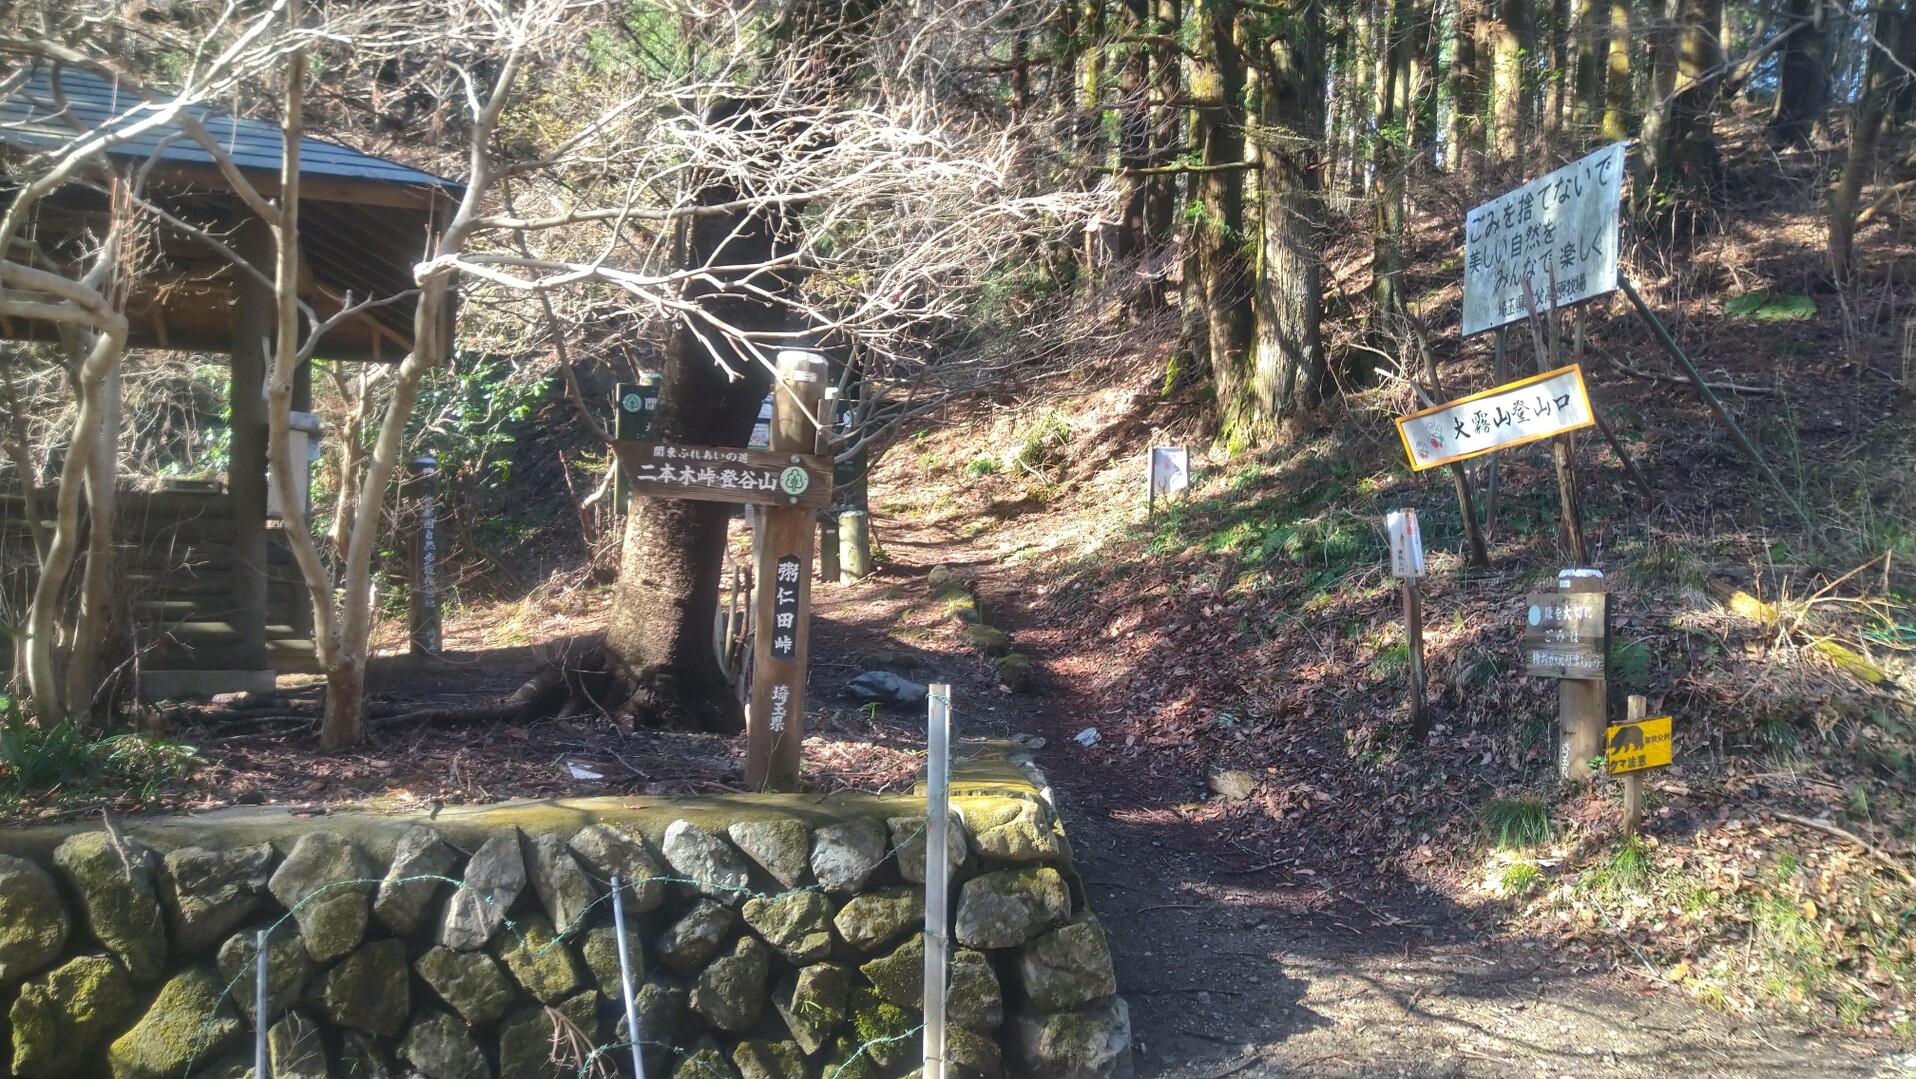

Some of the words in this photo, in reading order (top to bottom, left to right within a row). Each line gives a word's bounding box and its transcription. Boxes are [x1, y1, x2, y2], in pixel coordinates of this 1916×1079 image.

[1470, 154, 1612, 244] ごみを捨てないで
[1469, 217, 1557, 275] 美しい自然を
[1494, 226, 1603, 293] みんなで楽しく
[1454, 393, 1571, 440] 大霧山登山口
[653, 445, 749, 463] 関東ふれあいの道
[774, 562, 800, 655] 粥仁田峠
[769, 685, 790, 733] 埼玉県
[1609, 755, 1646, 772] クマ注意
